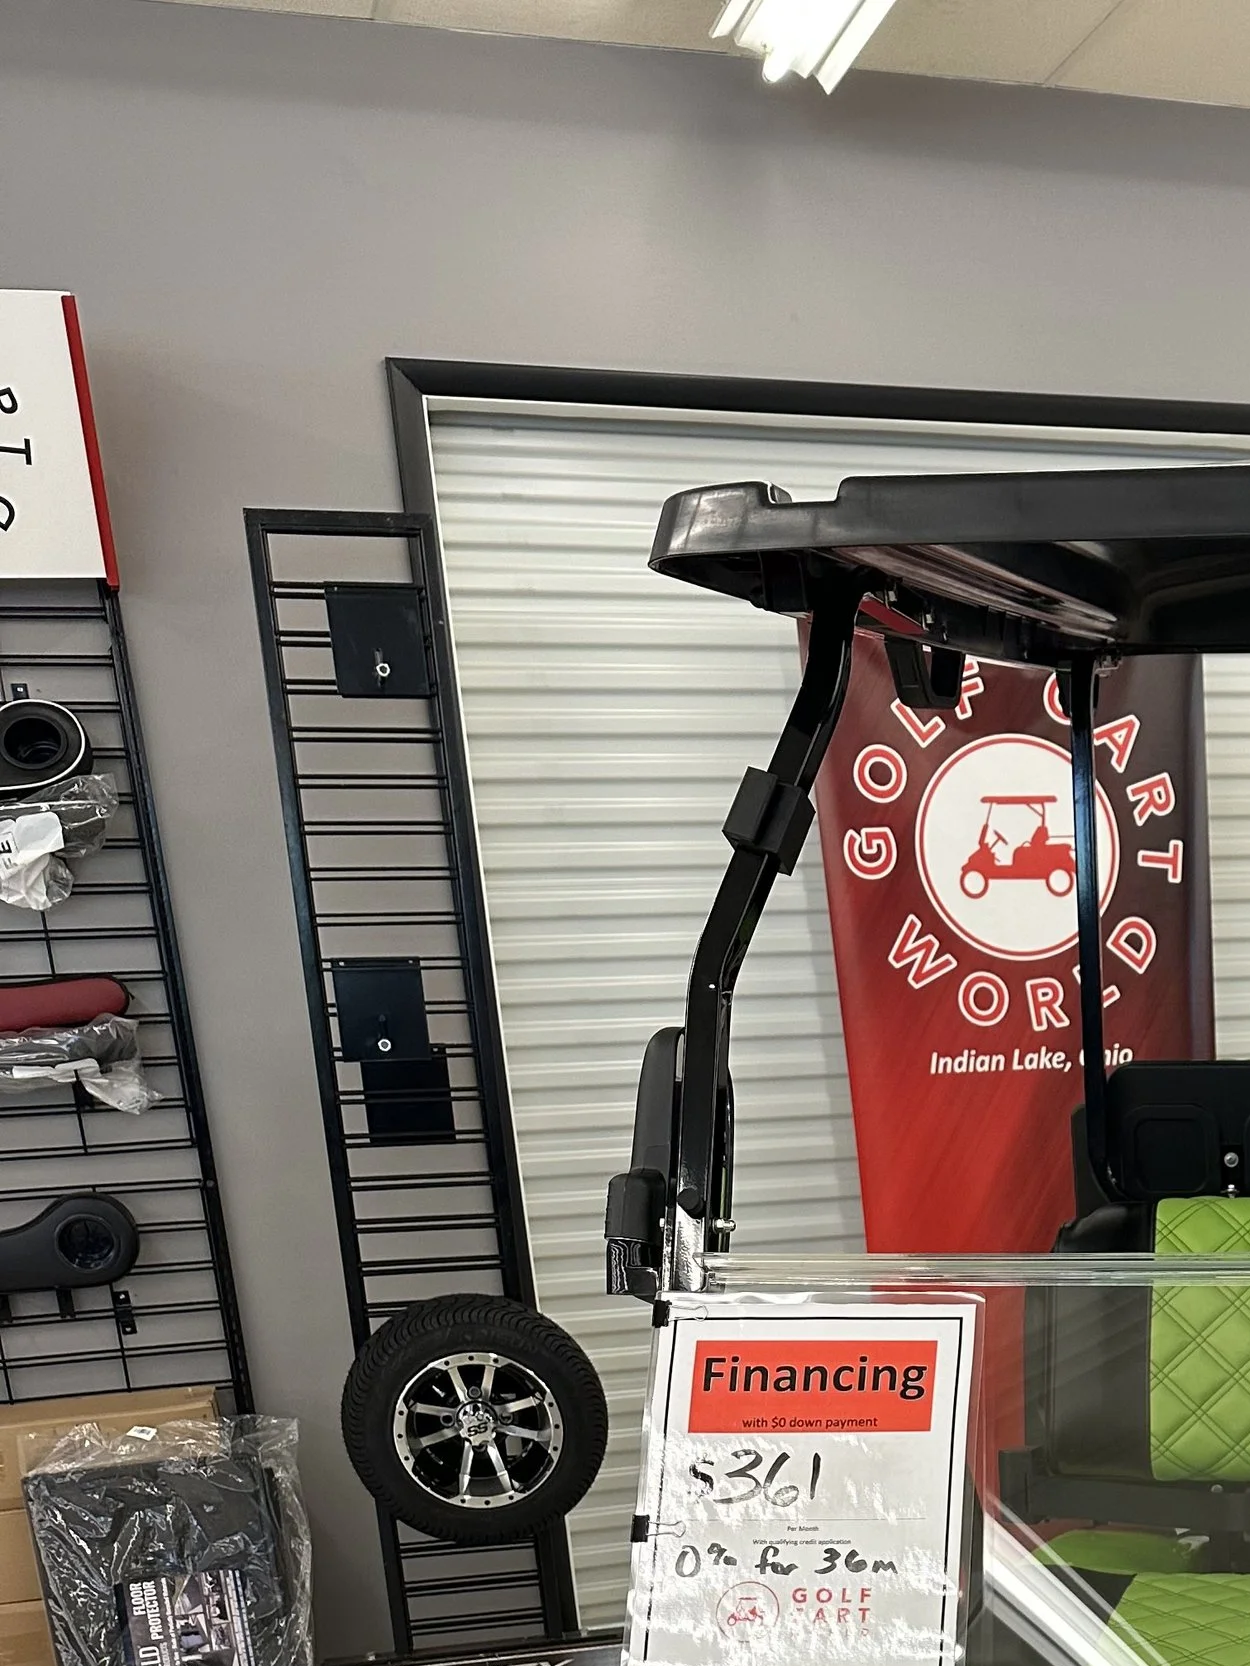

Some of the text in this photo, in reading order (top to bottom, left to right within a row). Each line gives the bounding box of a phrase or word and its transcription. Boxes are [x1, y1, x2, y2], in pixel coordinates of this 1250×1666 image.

[930, 1043, 1133, 1075] Indian Lake, io
[702, 1355, 928, 1400] Financing
[742, 1416, 878, 1432] with $0 down payment
[688, 1448, 821, 1507] $361
[755, 1545, 799, 1576] for
[130, 1582, 146, 1616] FLOOR
[142, 1580, 165, 1641] PROTECTOR
[792, 1588, 872, 1603] GOLF
[792, 1607, 871, 1623] ART
